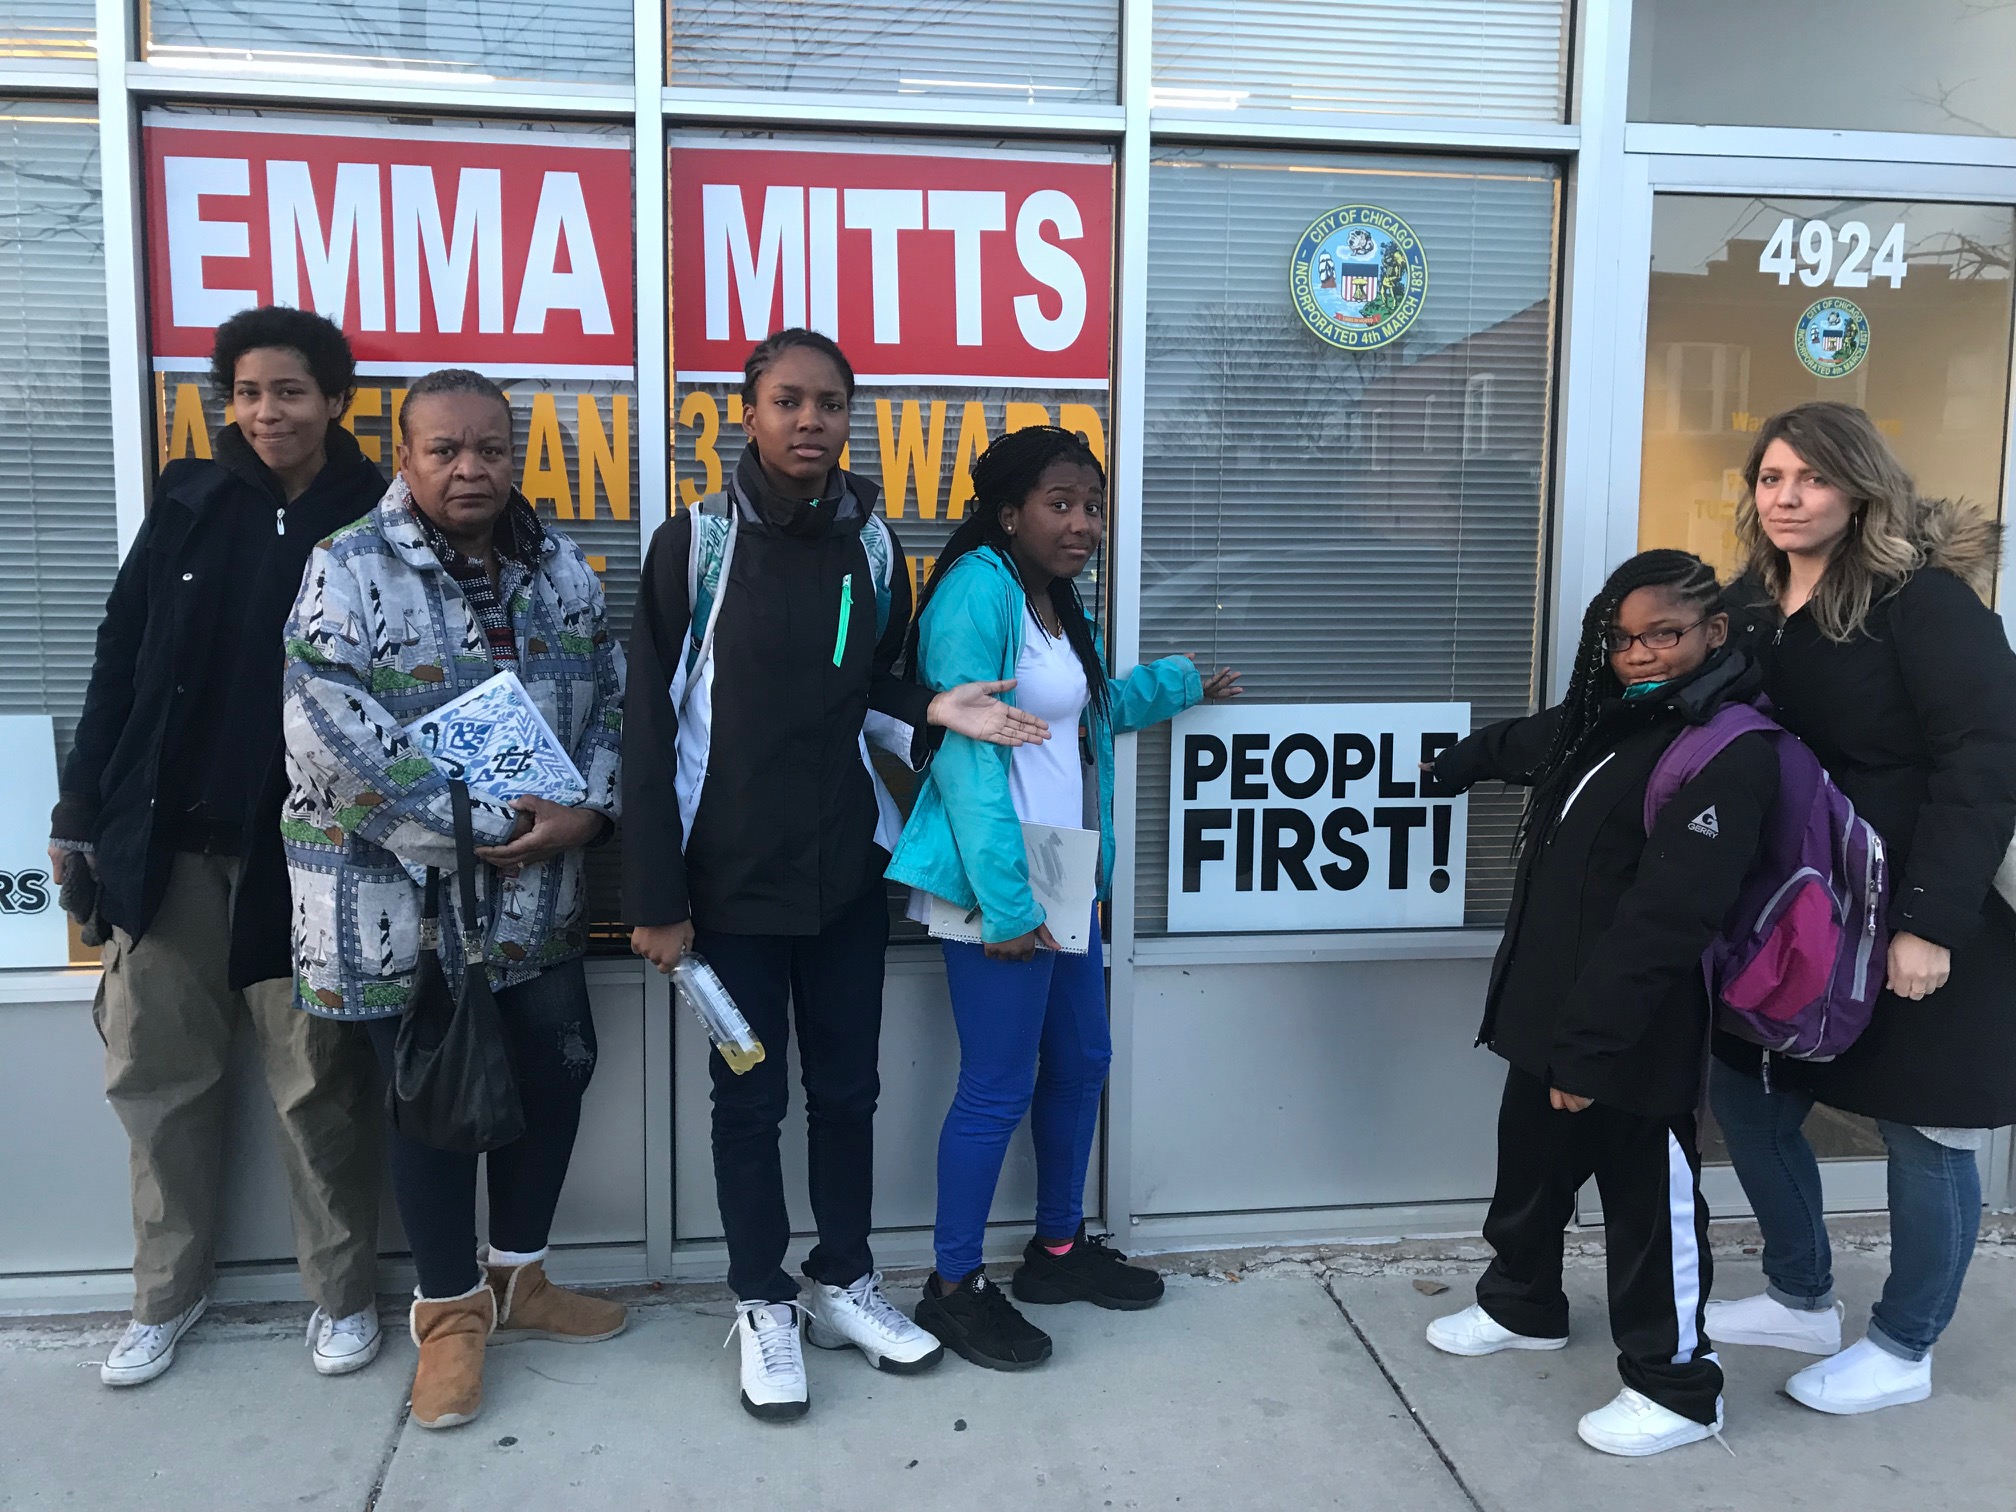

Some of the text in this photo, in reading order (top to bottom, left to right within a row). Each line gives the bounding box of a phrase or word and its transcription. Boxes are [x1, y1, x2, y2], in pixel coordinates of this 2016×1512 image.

[163, 155, 1087, 352] EMMA MITTS
[1310, 210, 1414, 250] CITY OF CHICAGO
[1759, 218, 1908, 289] 4924
[1295, 261, 1423, 344] INCORPORATED 4th MARCH 1837
[1806, 300, 1863, 322] CITY OF CHICAGO
[1797, 328, 1831, 375] INCORPORATED
[1843, 347, 1865, 371] MARCH
[1183, 732, 1459, 800] PEOPLE
[1182, 804, 1452, 893] FIRST!
[1687, 822, 1719, 839] GERRY
